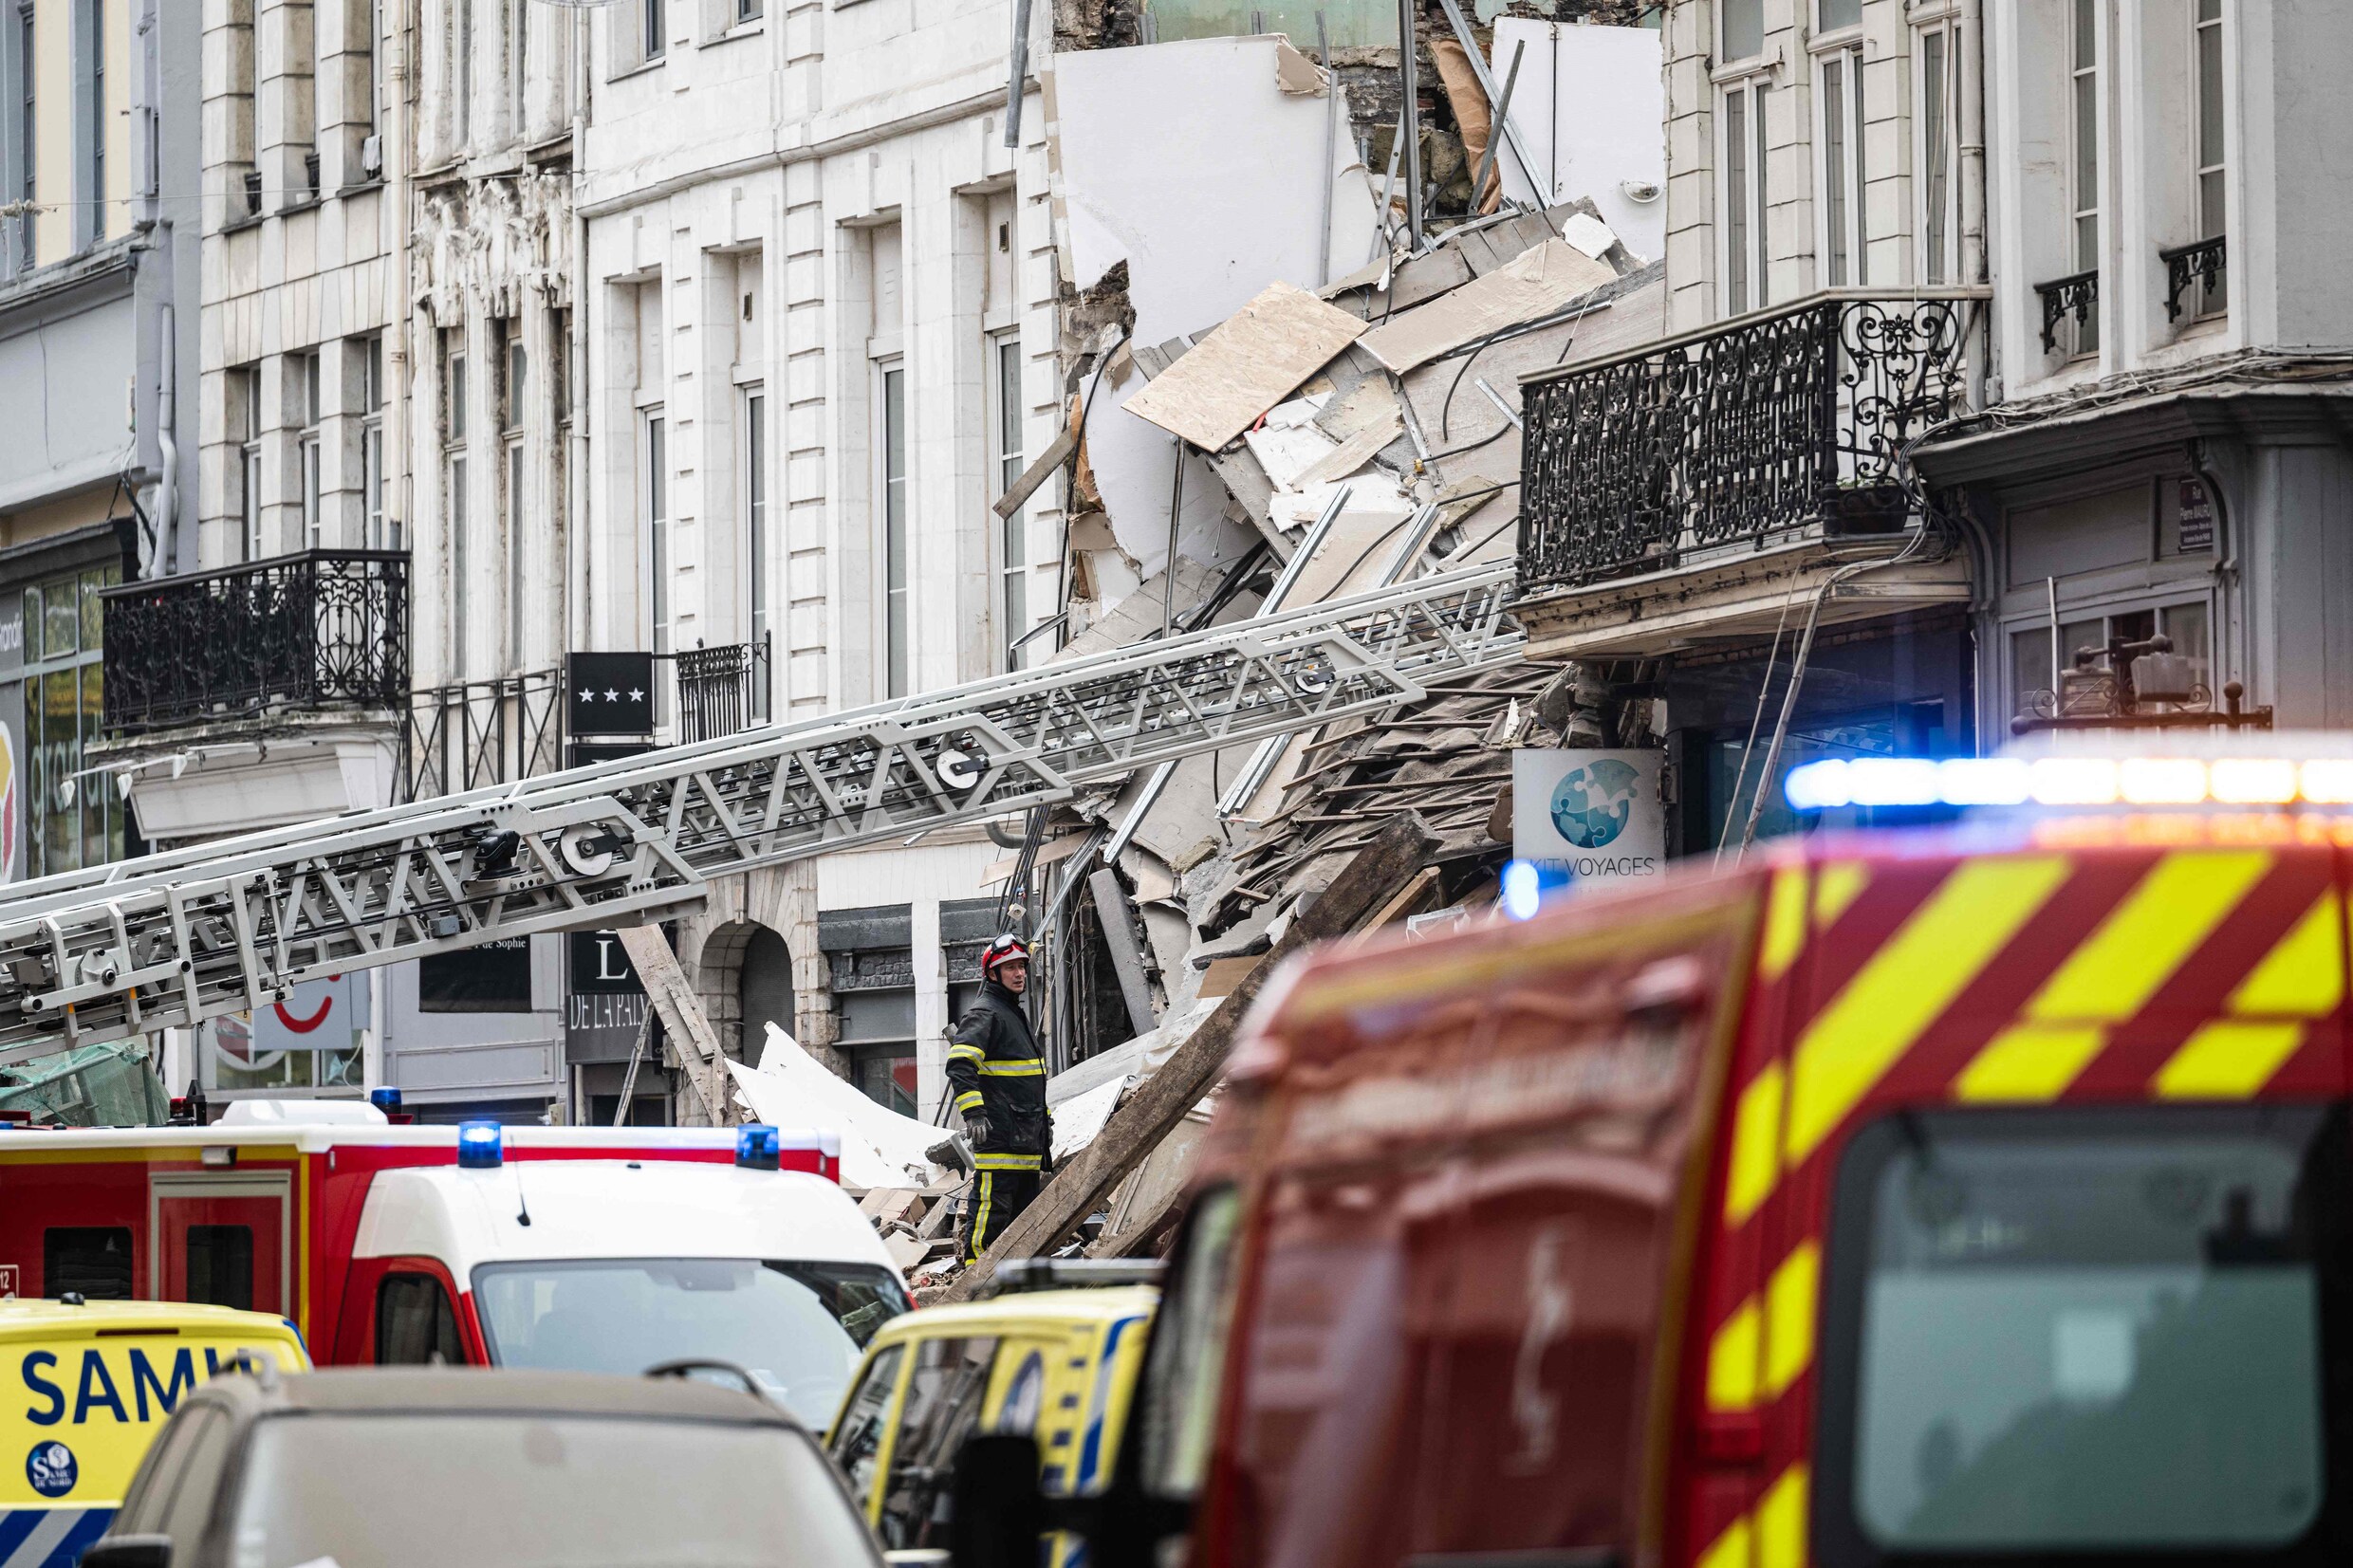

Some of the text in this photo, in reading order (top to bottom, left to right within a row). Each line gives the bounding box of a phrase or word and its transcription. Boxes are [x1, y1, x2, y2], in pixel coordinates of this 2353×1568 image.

[1564, 857, 1655, 876] VOYAGES
[495, 937, 527, 950] Sophie
[570, 994, 589, 1030] DE
[594, 994, 613, 1028] LA
